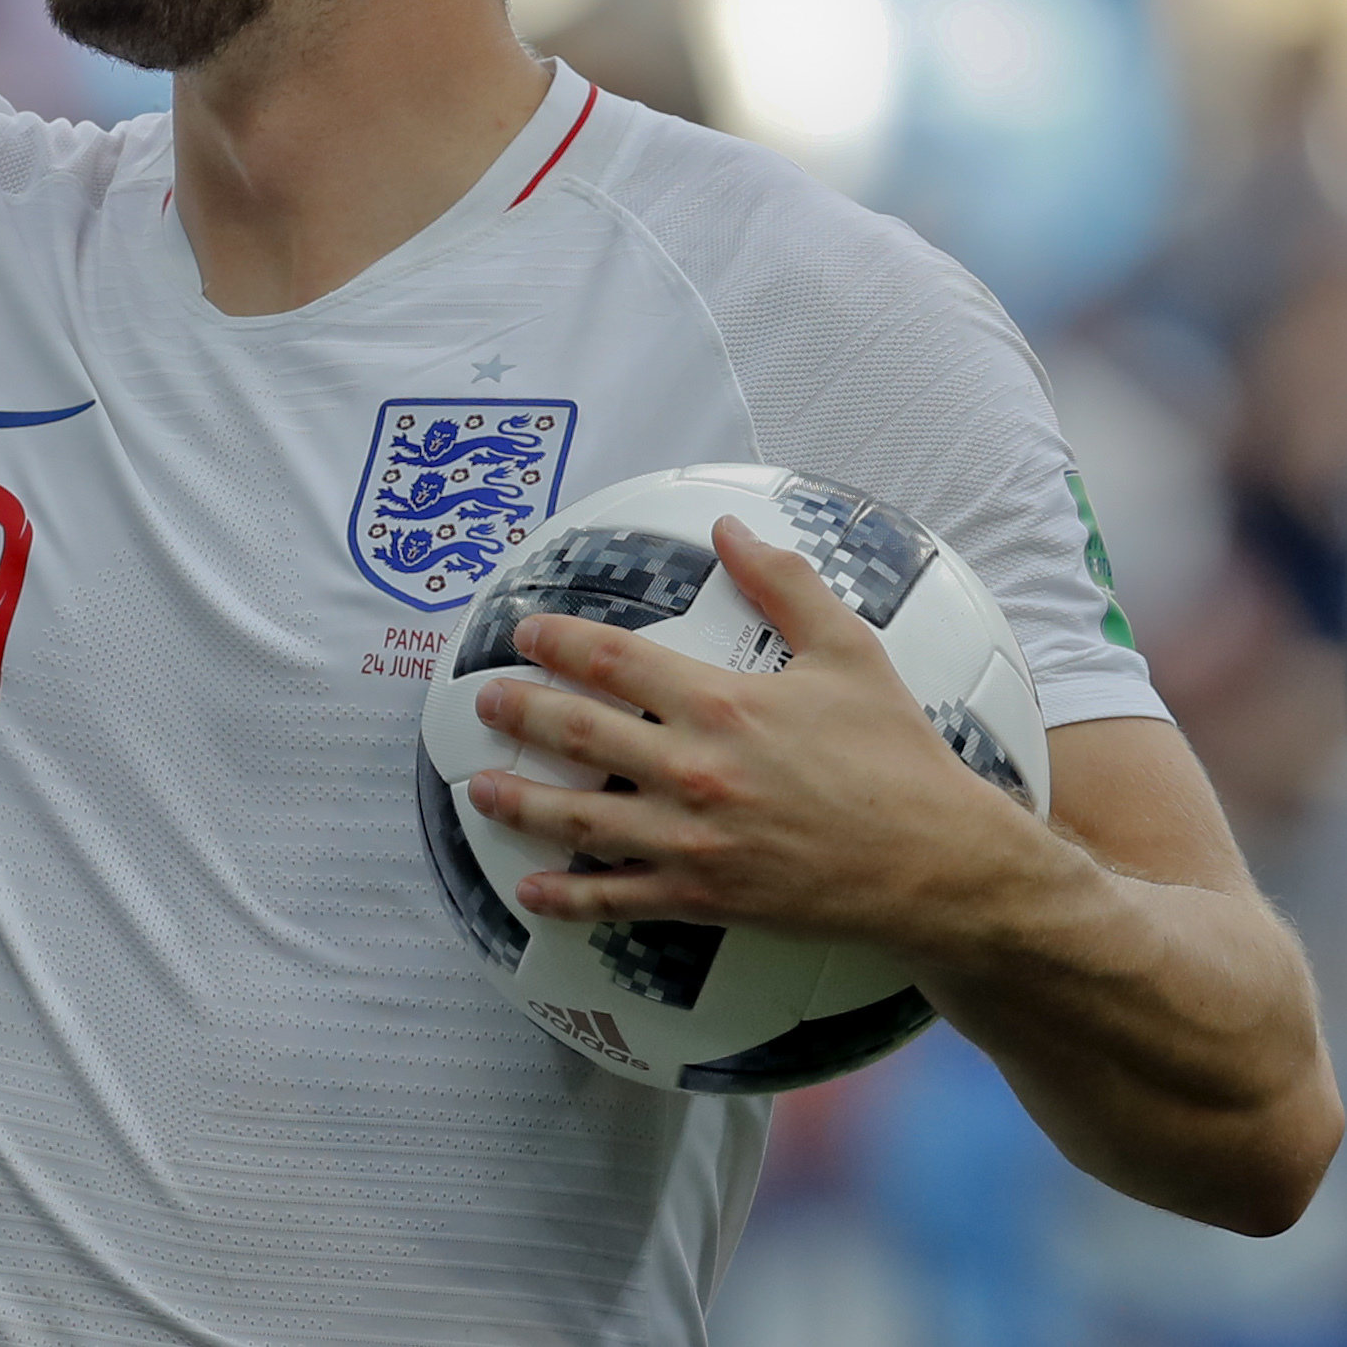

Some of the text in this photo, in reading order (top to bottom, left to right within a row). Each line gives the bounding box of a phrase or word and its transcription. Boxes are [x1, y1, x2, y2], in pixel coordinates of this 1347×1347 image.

[384, 627, 448, 654] PANAM
[361, 653, 436, 680] 24 JUNE
[527, 1000, 650, 1071] adidas
